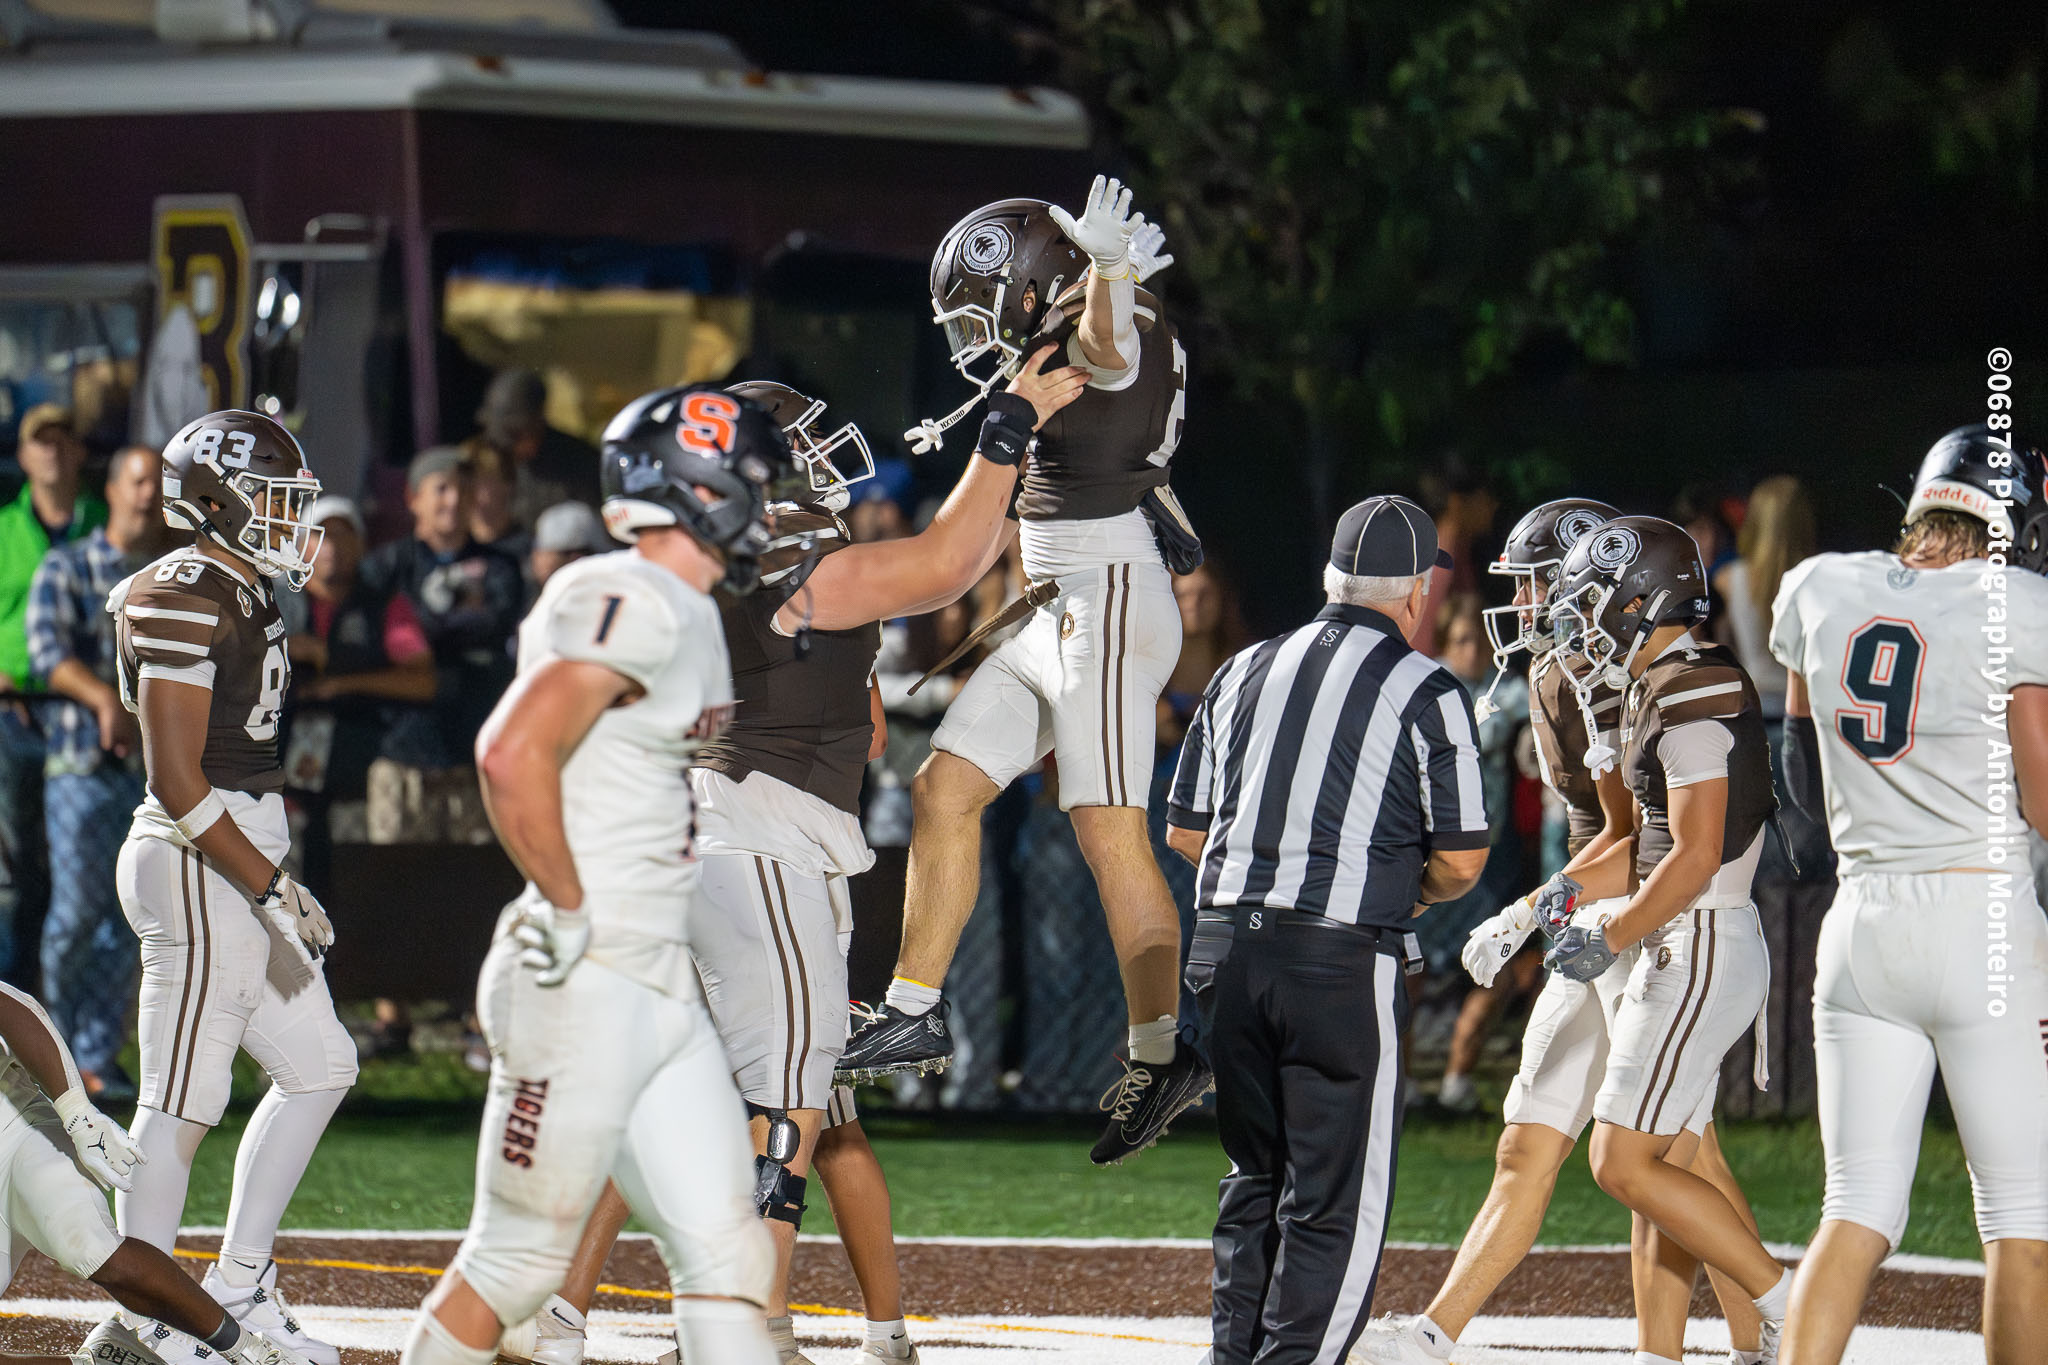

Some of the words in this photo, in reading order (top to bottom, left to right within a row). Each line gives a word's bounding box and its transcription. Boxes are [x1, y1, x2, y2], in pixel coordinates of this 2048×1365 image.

[676, 391, 741, 457] S
[940, 409, 965, 430] NXTRND
[193, 429, 256, 469] 83
[154, 561, 205, 585] 83
[593, 593, 625, 647] 1
[1835, 616, 1927, 765] 9
[503, 1077, 549, 1170] TIGERS
